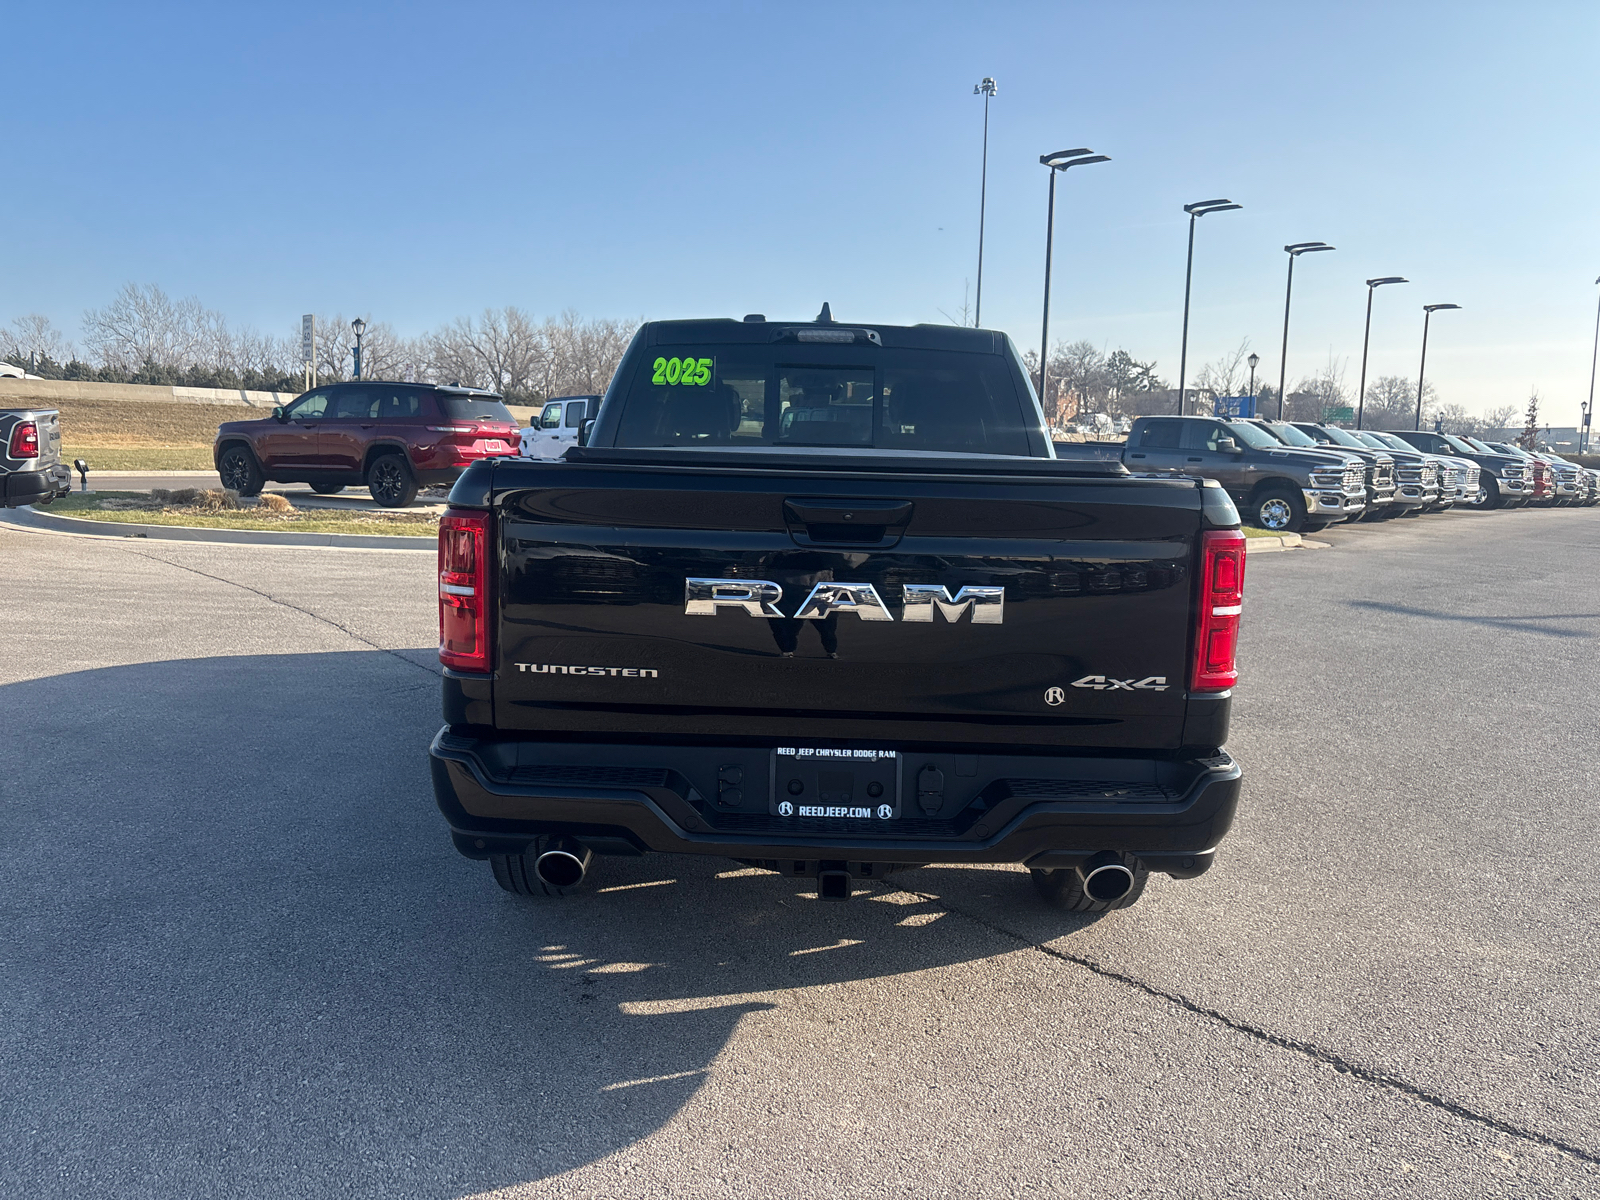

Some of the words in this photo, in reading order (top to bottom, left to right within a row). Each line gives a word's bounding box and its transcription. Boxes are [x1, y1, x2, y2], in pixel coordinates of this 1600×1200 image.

[652, 357, 713, 386] 2025
[685, 577, 1005, 624] RAM
[514, 663, 658, 678] TUNGSTEN
[1070, 675, 1171, 691] 4x4
[777, 747, 796, 755] REED
[797, 748, 814, 756] JEEP
[816, 749, 852, 757] CHRYSLER
[853, 750, 877, 758] DODGE
[799, 806, 871, 818] REEDJEEP.COM
